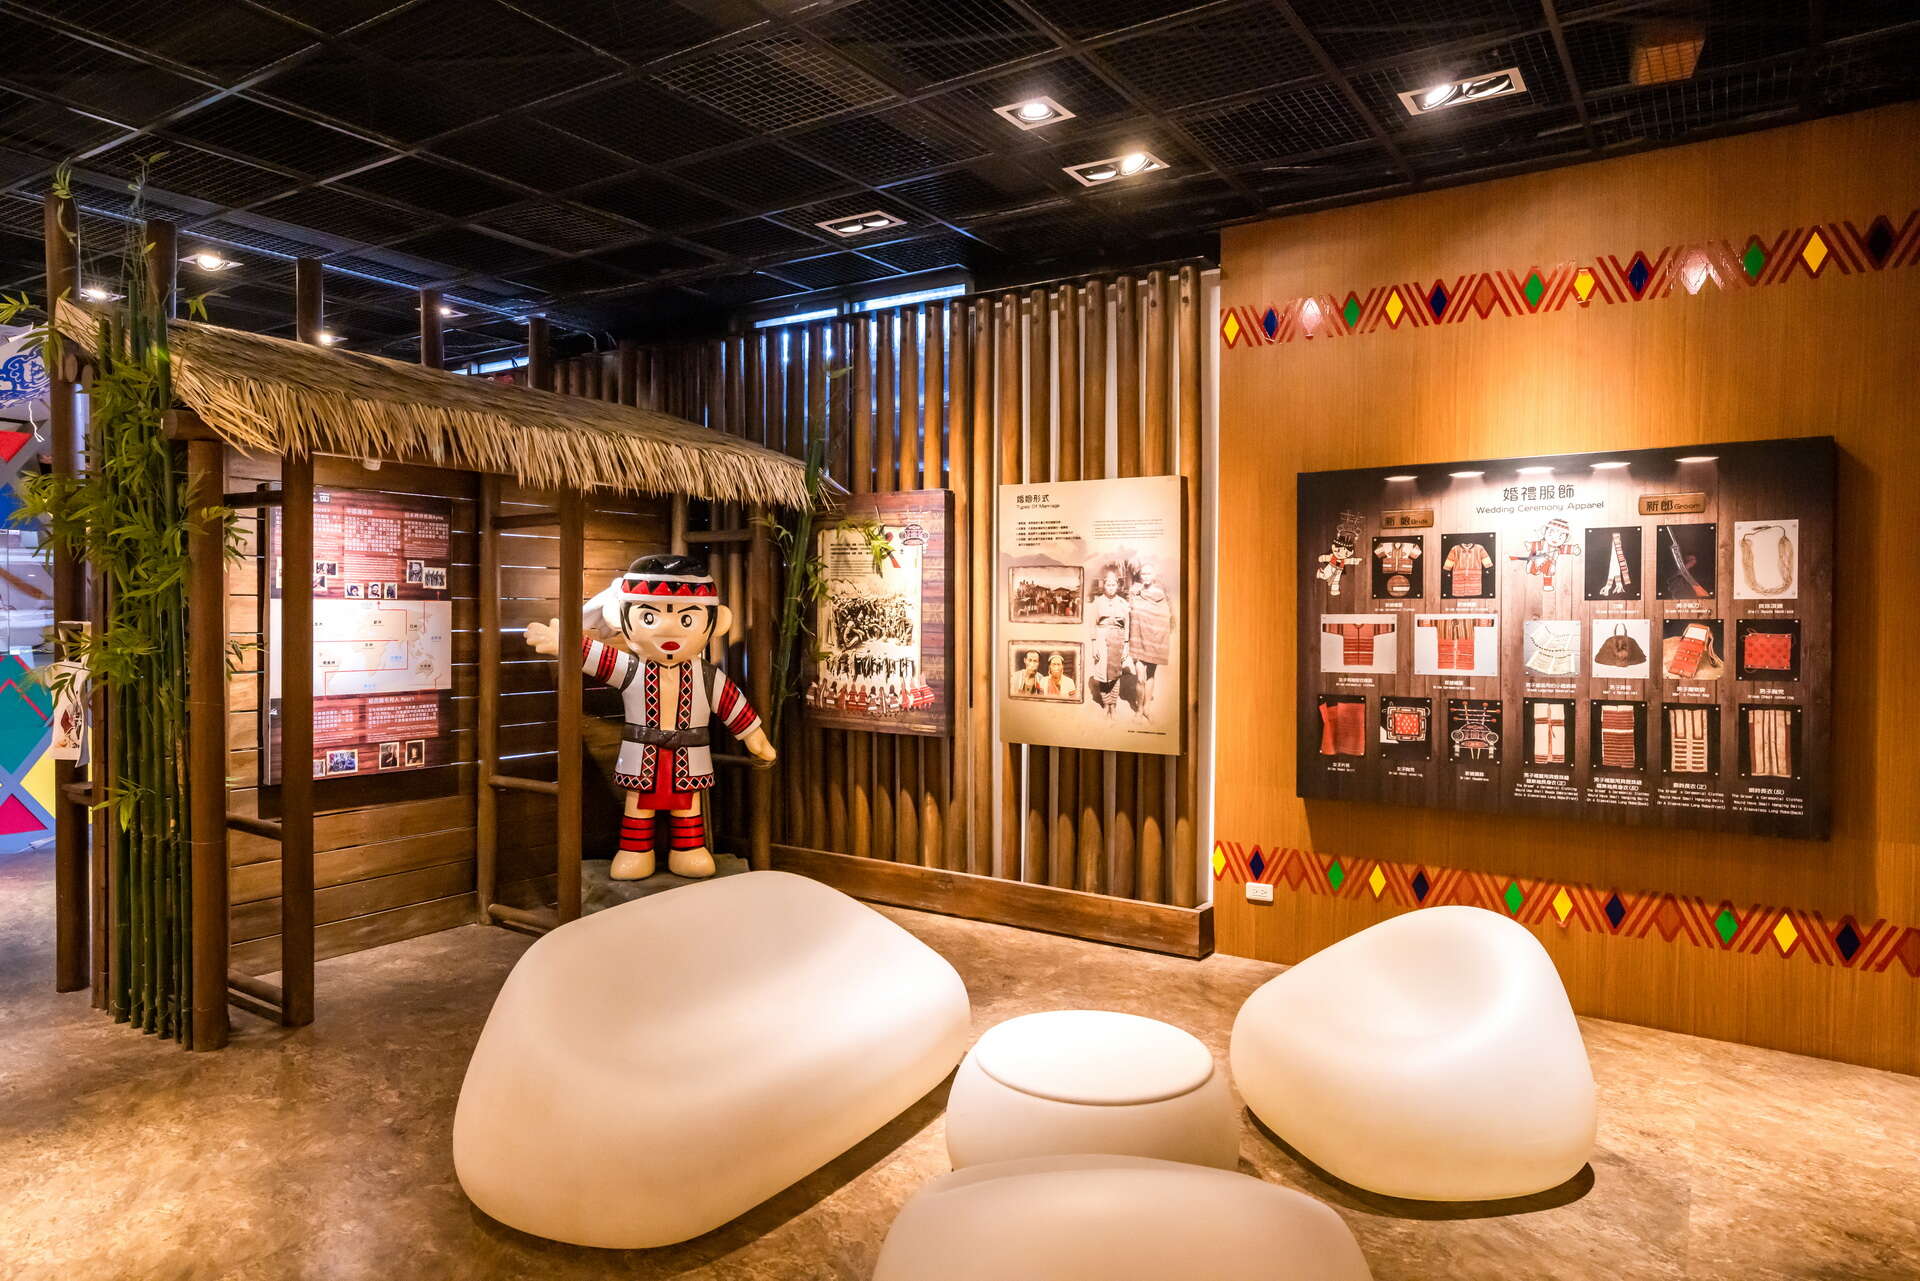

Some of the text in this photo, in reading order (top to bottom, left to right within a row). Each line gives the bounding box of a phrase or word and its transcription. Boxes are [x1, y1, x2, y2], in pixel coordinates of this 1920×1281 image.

[1503, 485, 1574, 501] 婚禮服飾
[1476, 501, 1604, 514] Wedding Ceremony Apparel
